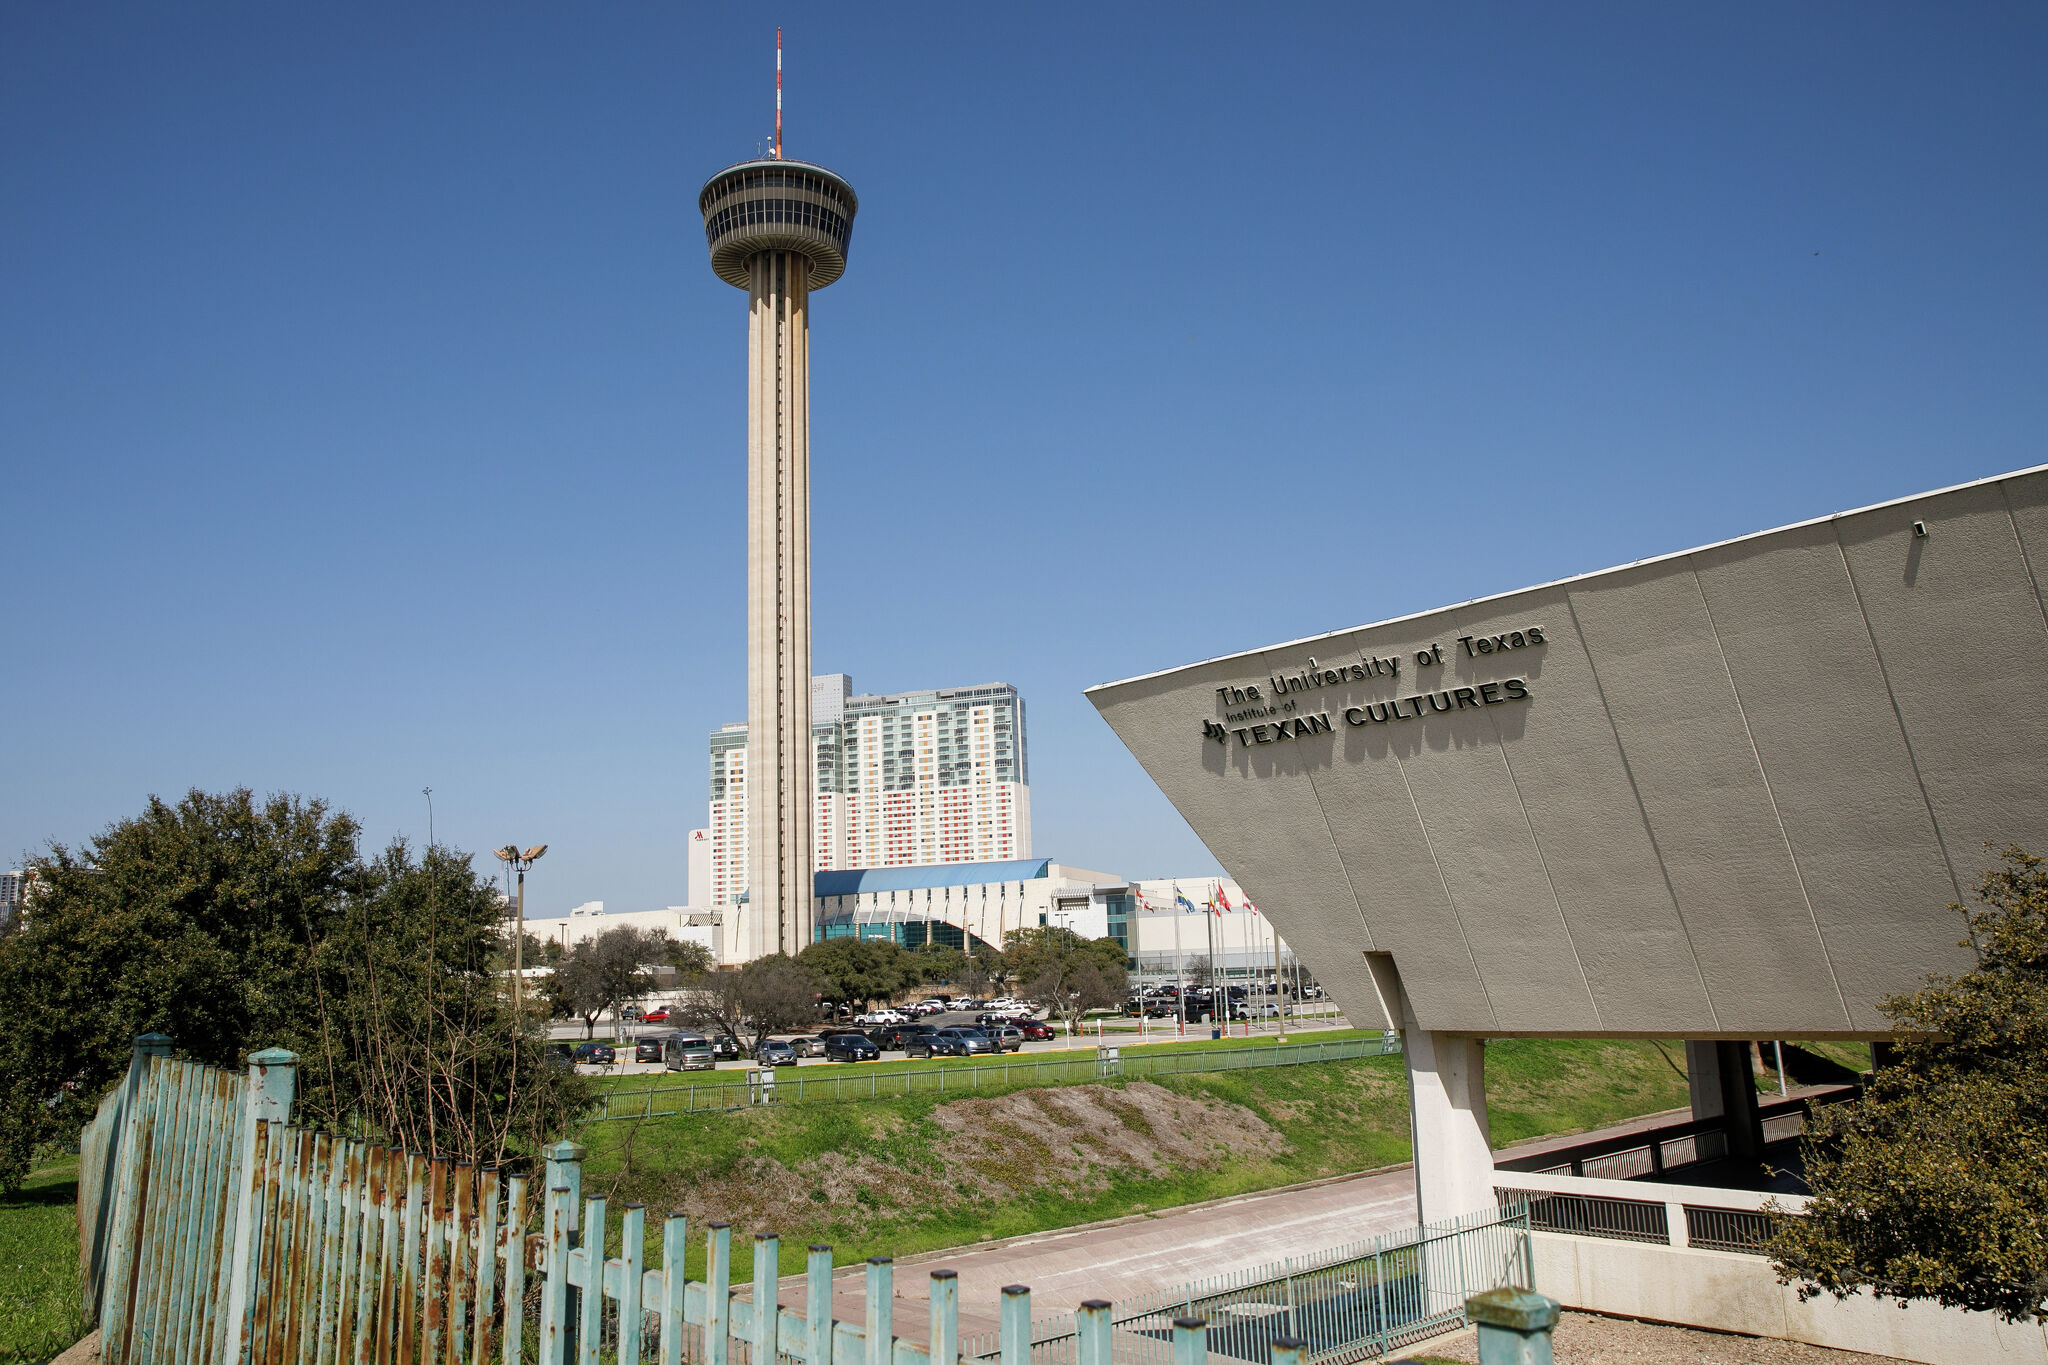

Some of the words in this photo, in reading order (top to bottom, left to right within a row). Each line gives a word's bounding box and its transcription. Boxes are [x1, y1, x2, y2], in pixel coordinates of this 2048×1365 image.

[1216, 684, 1262, 706] The
[1270, 655, 1398, 695] University
[1417, 642, 1444, 666] of
[1457, 627, 1546, 657] Texas
[1226, 705, 1277, 723] Institute
[1284, 699, 1297, 713] of
[1232, 712, 1334, 747] TEXAN
[1345, 678, 1530, 726] CULTURES
